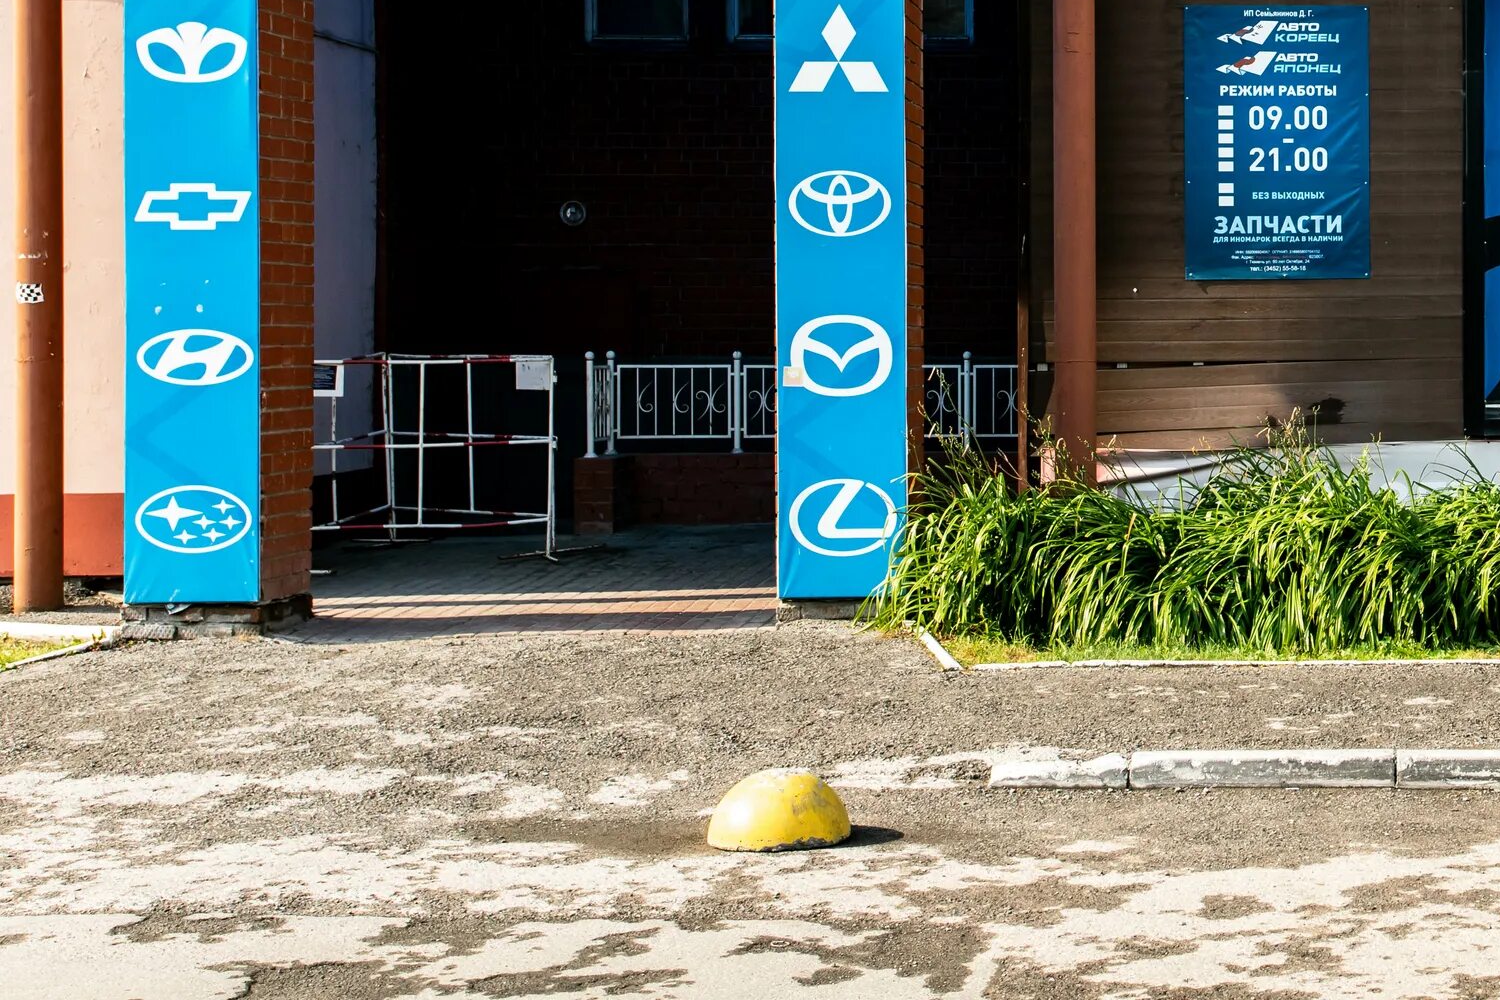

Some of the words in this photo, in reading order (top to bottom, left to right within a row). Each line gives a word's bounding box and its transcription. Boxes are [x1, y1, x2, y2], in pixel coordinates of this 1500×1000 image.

[1277, 22, 1320, 32] АВТО
[1275, 33, 1340, 44] КОРЕЕЦ
[1274, 53, 1319, 63] АВТО
[1273, 64, 1342, 75] ЯПОНЕЦ
[1219, 85, 1275, 97] РЕЖИМ
[1278, 85, 1338, 97] РАБОТЫ
[1248, 105, 1329, 131] 09.00
[1248, 147, 1329, 172] 21.00
[1251, 191, 1270, 201] БЕЗ
[1272, 191, 1326, 201] ВЫХОДНЫХ
[1213, 215, 1343, 235] ЗАПЧАСТИ
[1213, 236, 1229, 244] ДЛЯ
[1272, 235, 1301, 244] ВСЕГДА
